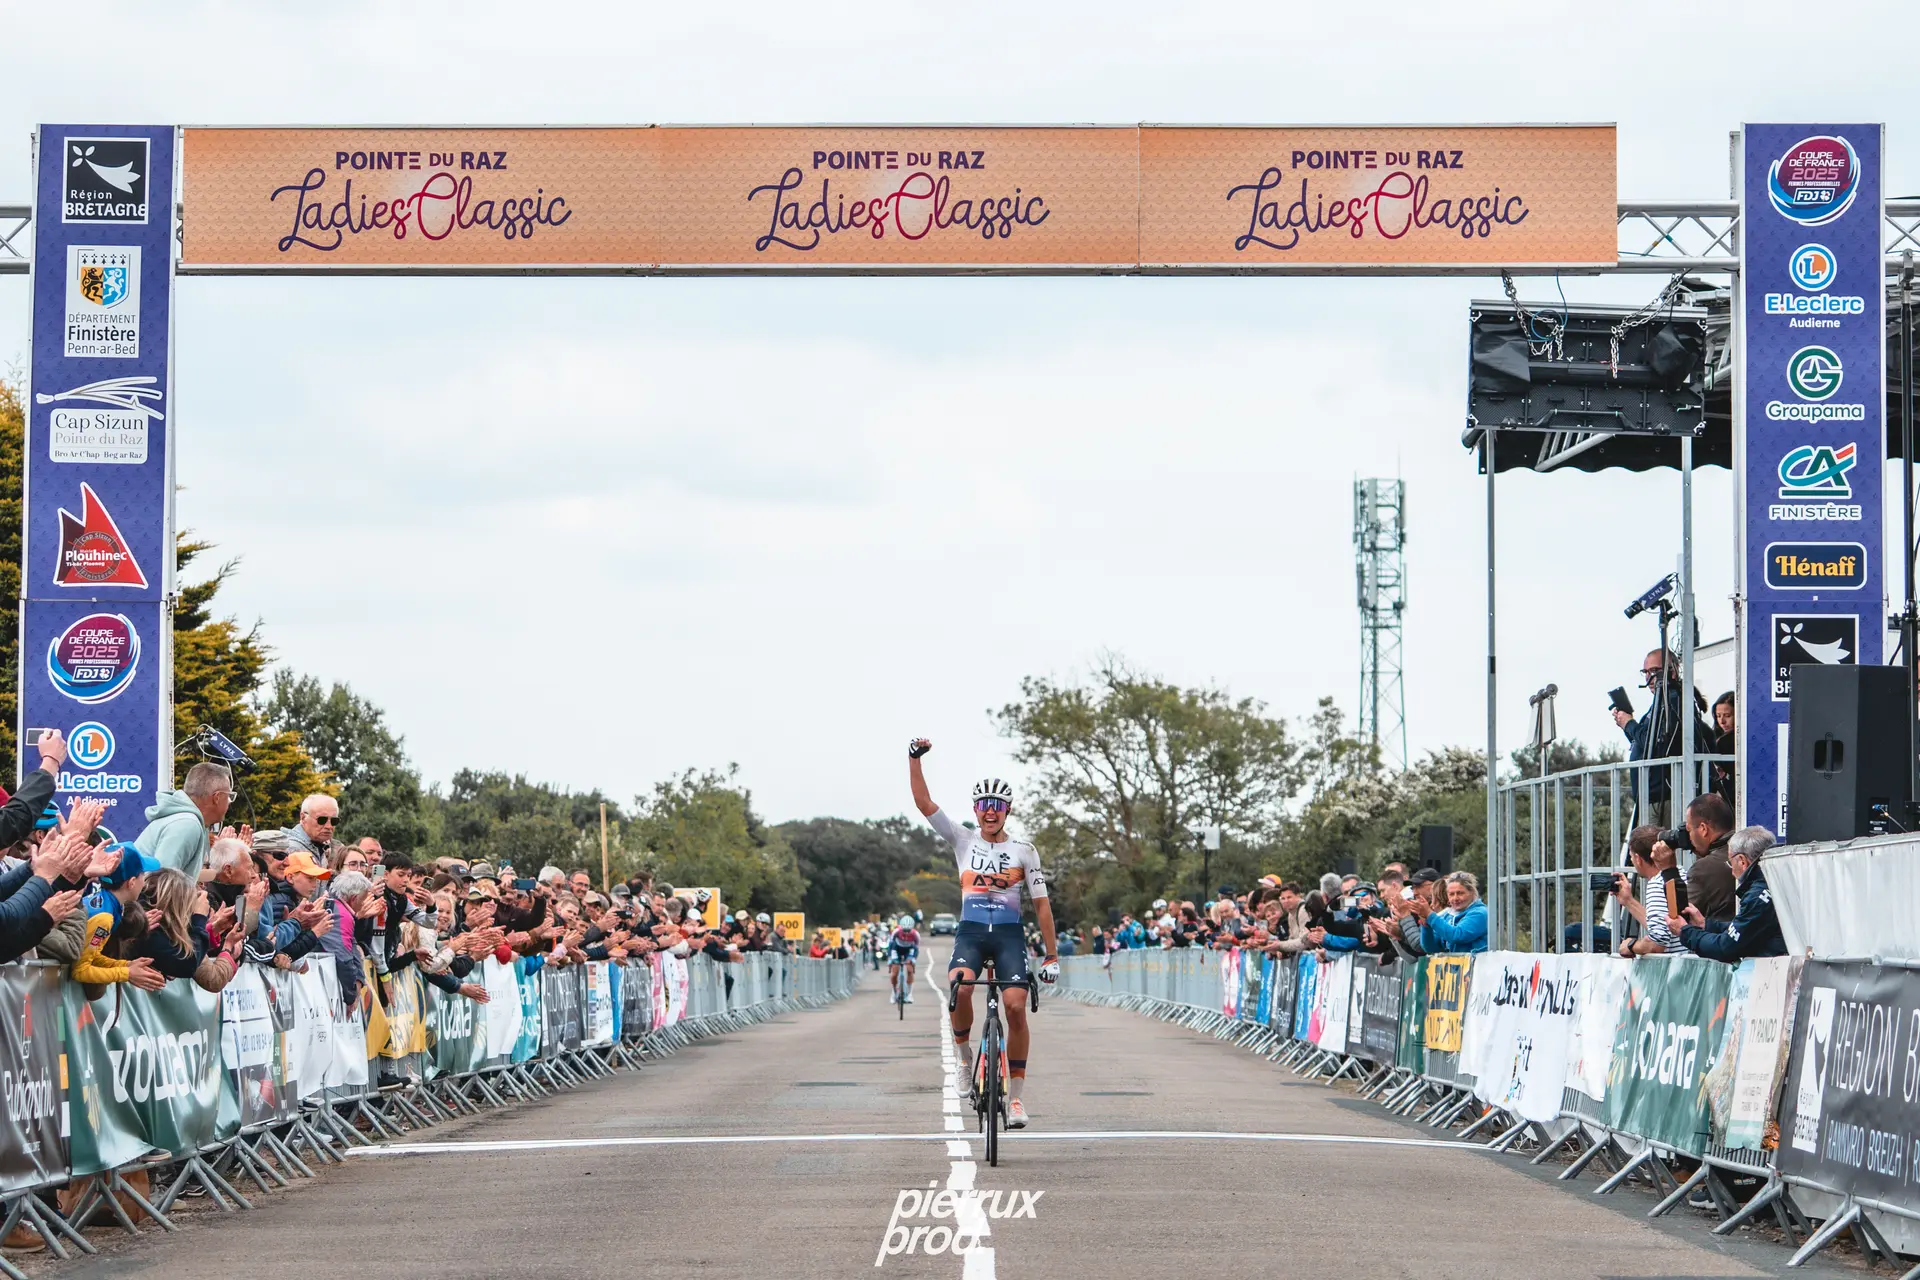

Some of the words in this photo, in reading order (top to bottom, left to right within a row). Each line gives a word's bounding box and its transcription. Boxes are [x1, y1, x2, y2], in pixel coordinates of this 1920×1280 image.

[335, 152, 422, 170] POINTE
[429, 152, 454, 167] DU
[460, 152, 508, 170] RAZ
[812, 150, 899, 170] POINTE
[906, 152, 932, 166] DU
[938, 150, 985, 170] RAZ
[1292, 150, 1378, 169] POINTE
[1385, 152, 1410, 166] DU
[1416, 150, 1464, 169] RAZ
[1799, 151, 1834, 160] COUPE
[1788, 159, 1802, 167] DE
[1804, 159, 1845, 167] FRANCE
[1792, 168, 1840, 180] 2025
[70, 188, 112, 200] Région
[1796, 190, 1820, 200] FDJ
[66, 202, 146, 217] BRETAGNE
[270, 168, 412, 252] Ladies
[407, 172, 573, 240] Classic
[748, 167, 890, 252] Ladies
[884, 172, 1050, 240] Classic
[1226, 166, 1368, 250] Ladies
[1363, 171, 1529, 240] Classic
[1766, 296, 1862, 312] E.Leclerc
[68, 312, 136, 324] DÉPARTEMENT
[1789, 318, 1840, 328] Audierne
[68, 326, 136, 342] Finistère
[68, 343, 136, 355] Penn-ar-Bed
[1768, 403, 1862, 422] Groupama
[56, 412, 90, 433] Cap
[94, 413, 144, 430] Sizun
[55, 432, 96, 444] Pointe
[100, 432, 116, 444] du
[120, 433, 144, 445] Raz
[54, 450, 68, 458] Bro
[104, 451, 118, 460] Beg
[130, 451, 143, 459] Raz
[1772, 504, 1860, 518] FINISTÈRE
[81, 534, 94, 543] Cap
[94, 532, 112, 544] Sizun
[66, 549, 127, 562] Plouhinec
[1775, 556, 1856, 577] Hénaff
[1646, 586, 1664, 600] LYNX
[80, 628, 114, 637] COUPE
[68, 636, 84, 644] DE
[84, 636, 126, 644] FRANCE
[72, 646, 120, 658] 2025
[76, 668, 99, 678] FDJ
[218, 740, 236, 756] LYNX
[58, 774, 139, 790] .Leclerc
[66, 796, 118, 806] Adierne
[971, 856, 1010, 876] UAE
[1831, 982, 1902, 1098] RÉGION
[1867, 1129, 1904, 1178] BREIZH
